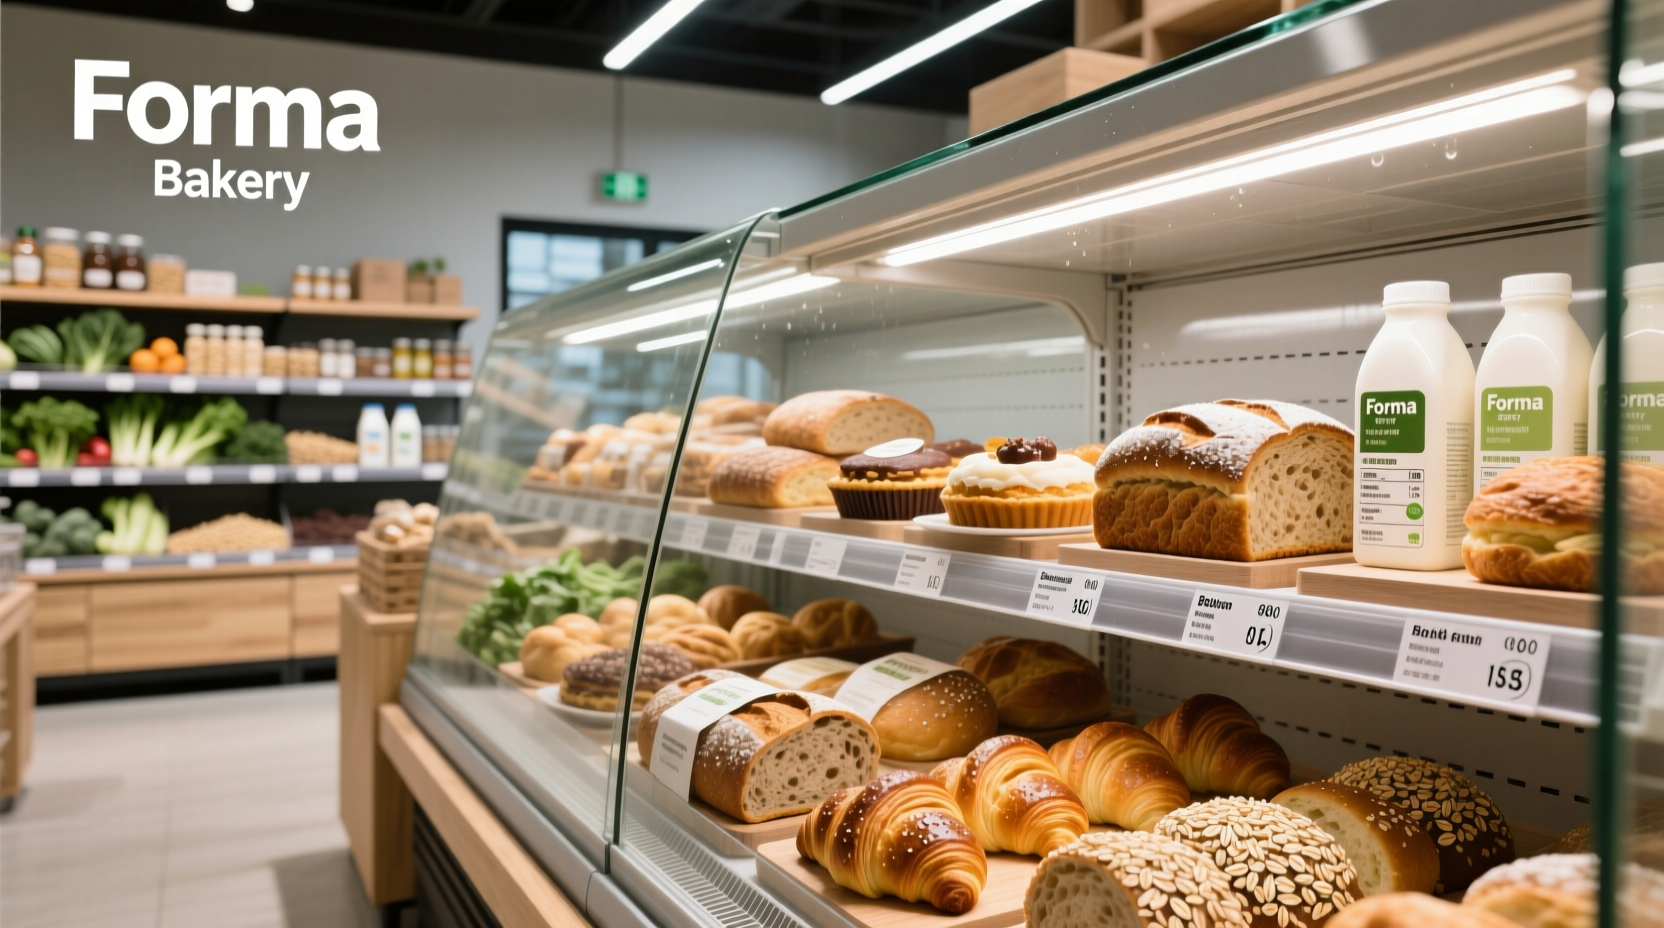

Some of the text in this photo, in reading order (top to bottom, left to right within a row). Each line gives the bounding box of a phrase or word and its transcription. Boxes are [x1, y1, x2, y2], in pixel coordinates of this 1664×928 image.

[74, 59, 381, 151] Forma
[155, 159, 310, 211] Bakery
[1366, 398, 1417, 415] Forma
[1487, 393, 1544, 411] Forma
[1618, 393, 1664, 409] orma
